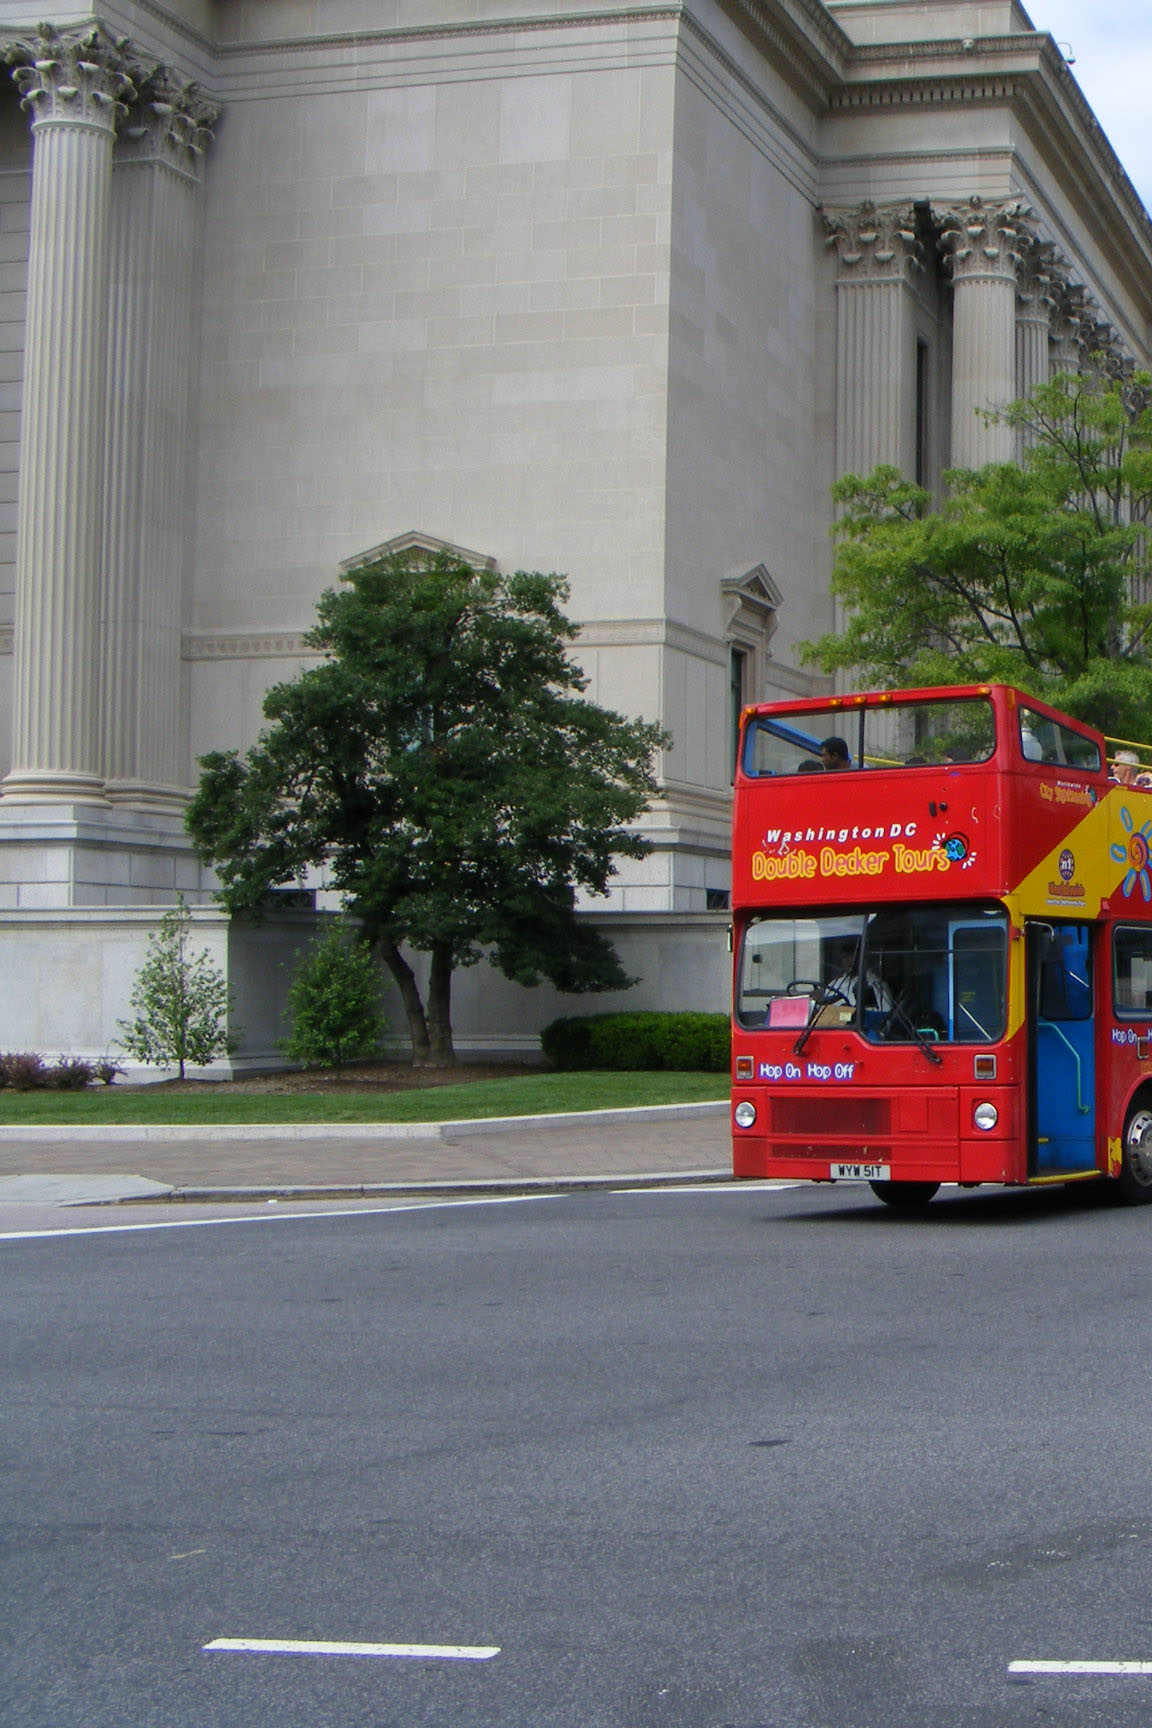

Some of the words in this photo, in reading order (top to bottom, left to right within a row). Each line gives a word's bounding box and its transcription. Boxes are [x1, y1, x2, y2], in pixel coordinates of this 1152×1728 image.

[766, 826, 884, 845] Washington
[889, 822, 917, 838] DC
[752, 850, 818, 880] Double
[820, 846, 889, 877] Decker
[892, 843, 951, 873] Tours
[1112, 1028, 1127, 1044] Hop
[1127, 1028, 1138, 1043] On
[760, 1063, 783, 1080] Hop
[785, 1063, 801, 1079] On
[807, 1063, 831, 1080] Hop
[834, 1063, 855, 1079] Off
[838, 1164, 860, 1177] WYW
[863, 1165, 882, 1178] 51T
